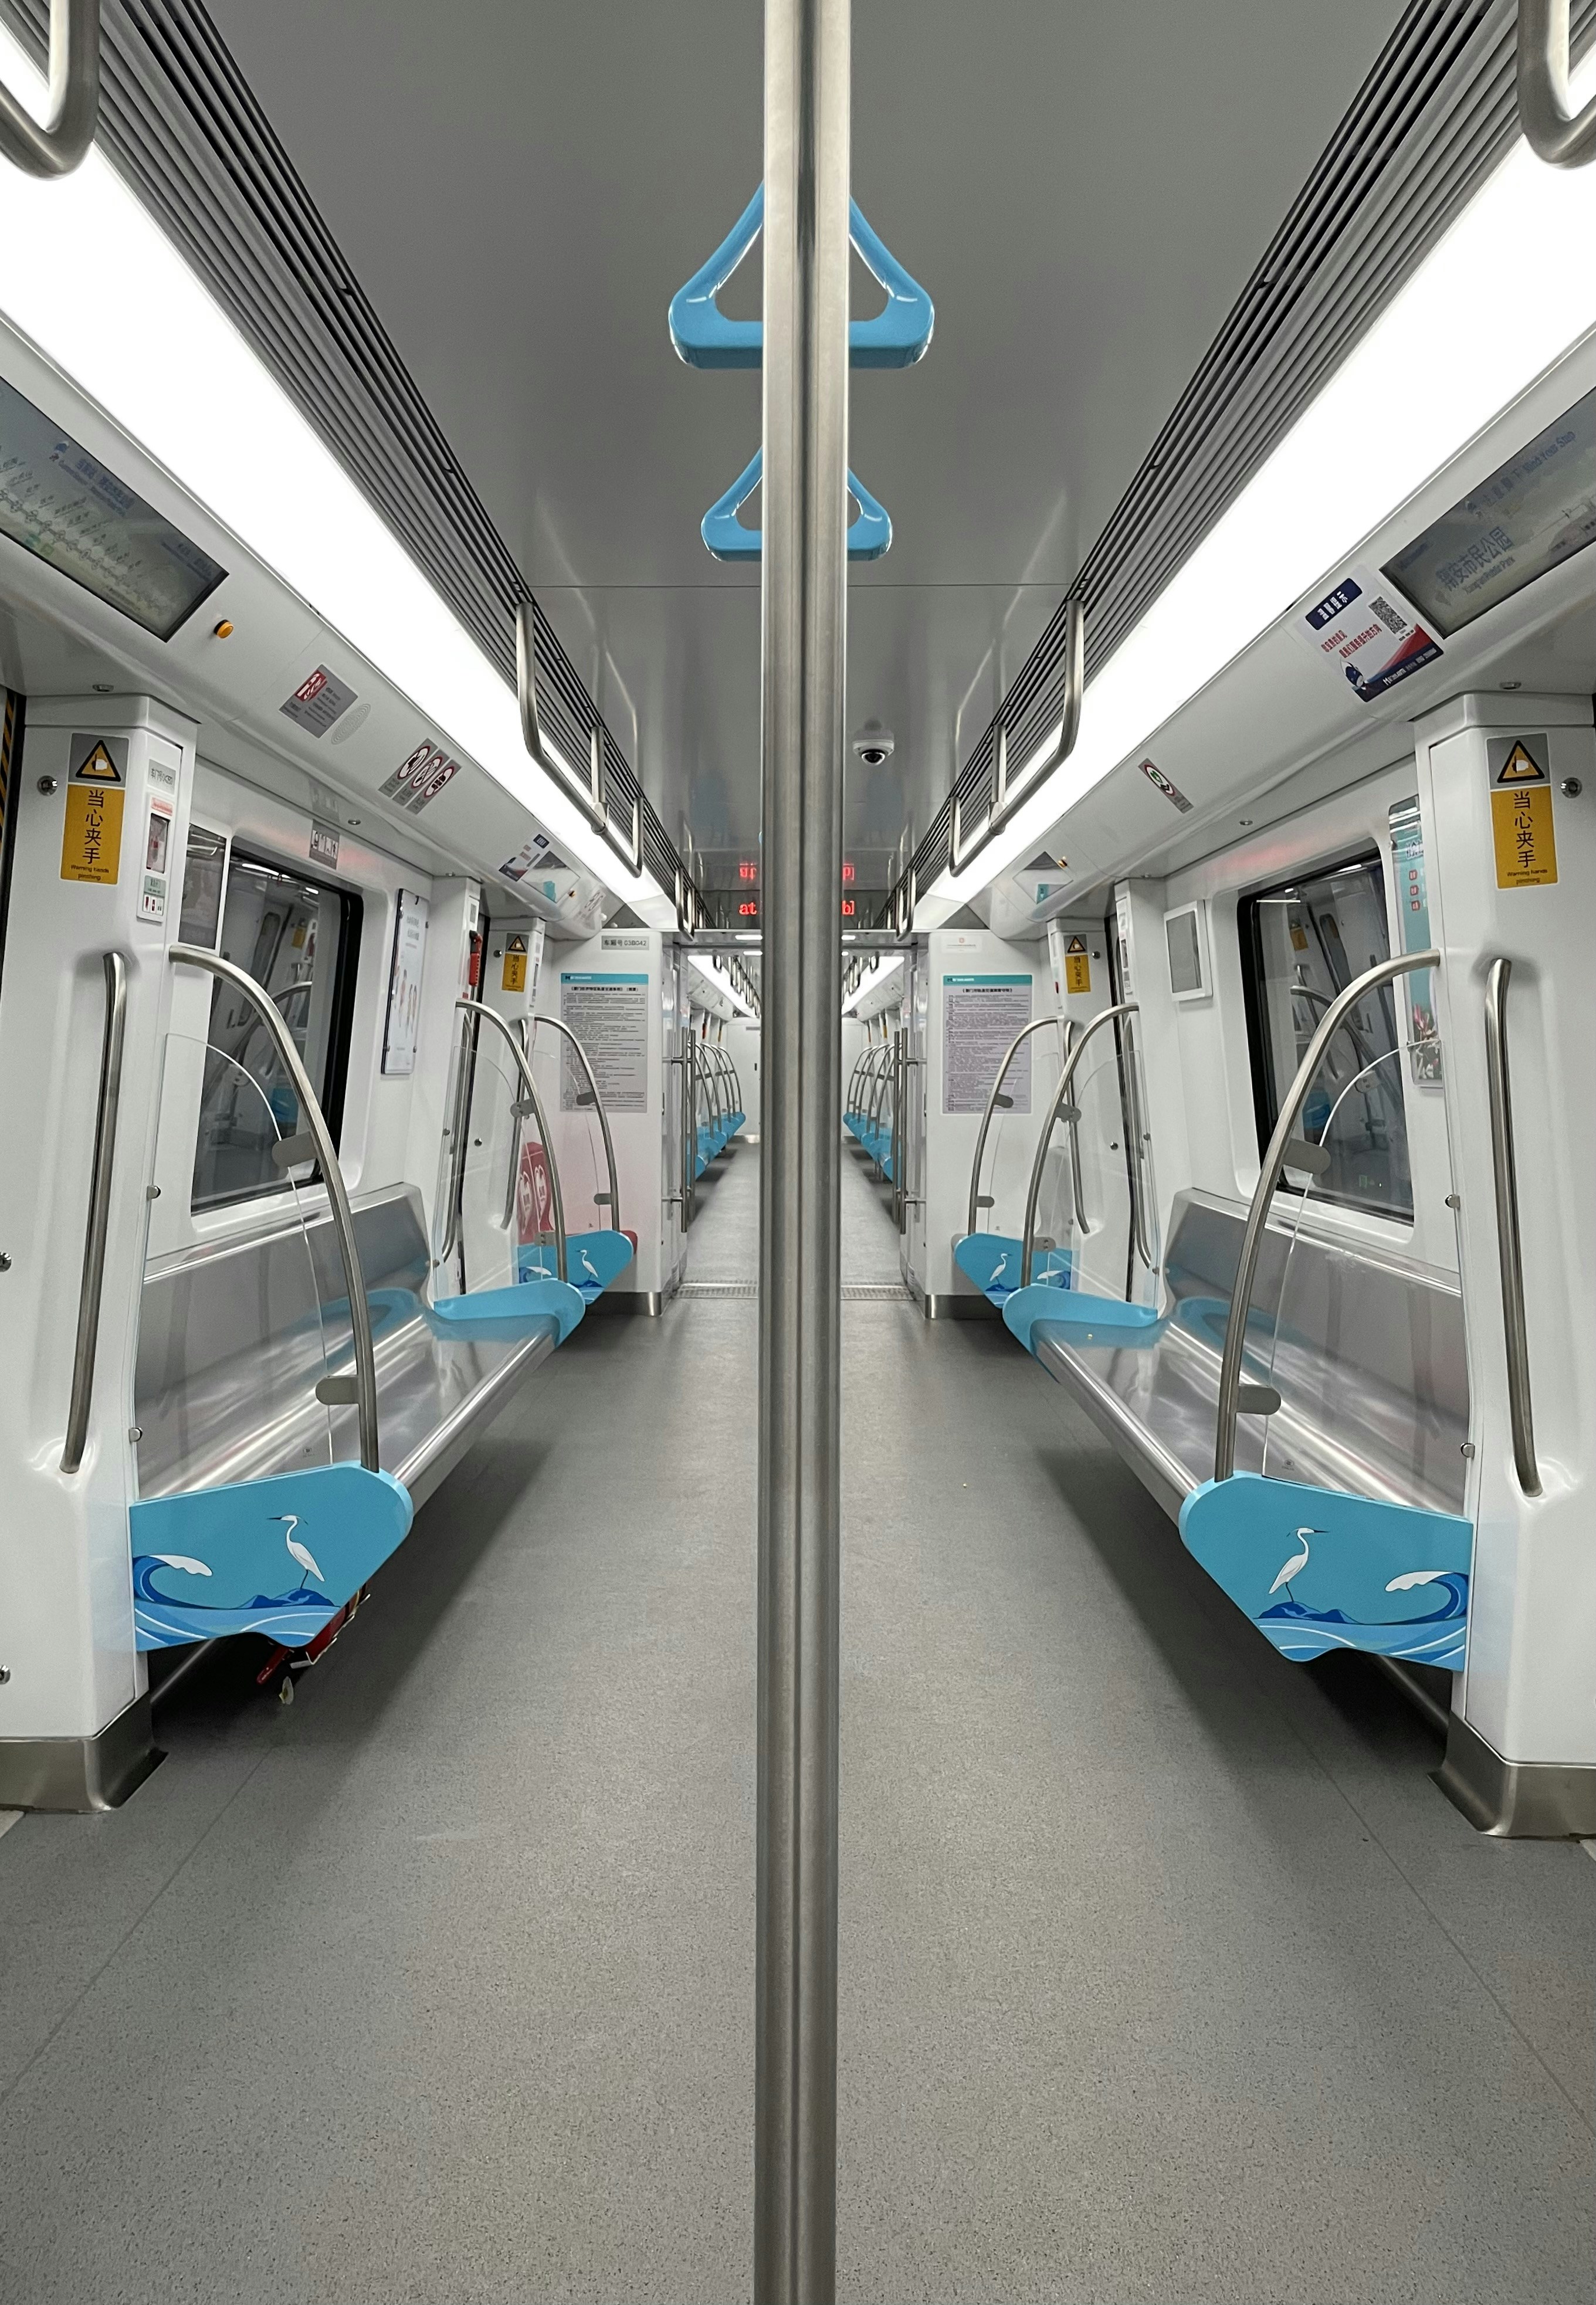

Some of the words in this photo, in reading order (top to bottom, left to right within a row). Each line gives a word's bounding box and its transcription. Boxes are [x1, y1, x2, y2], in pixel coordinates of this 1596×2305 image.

[82, 789, 104, 865] 当心夹手
[1513, 791, 1536, 868] 当心夹手
